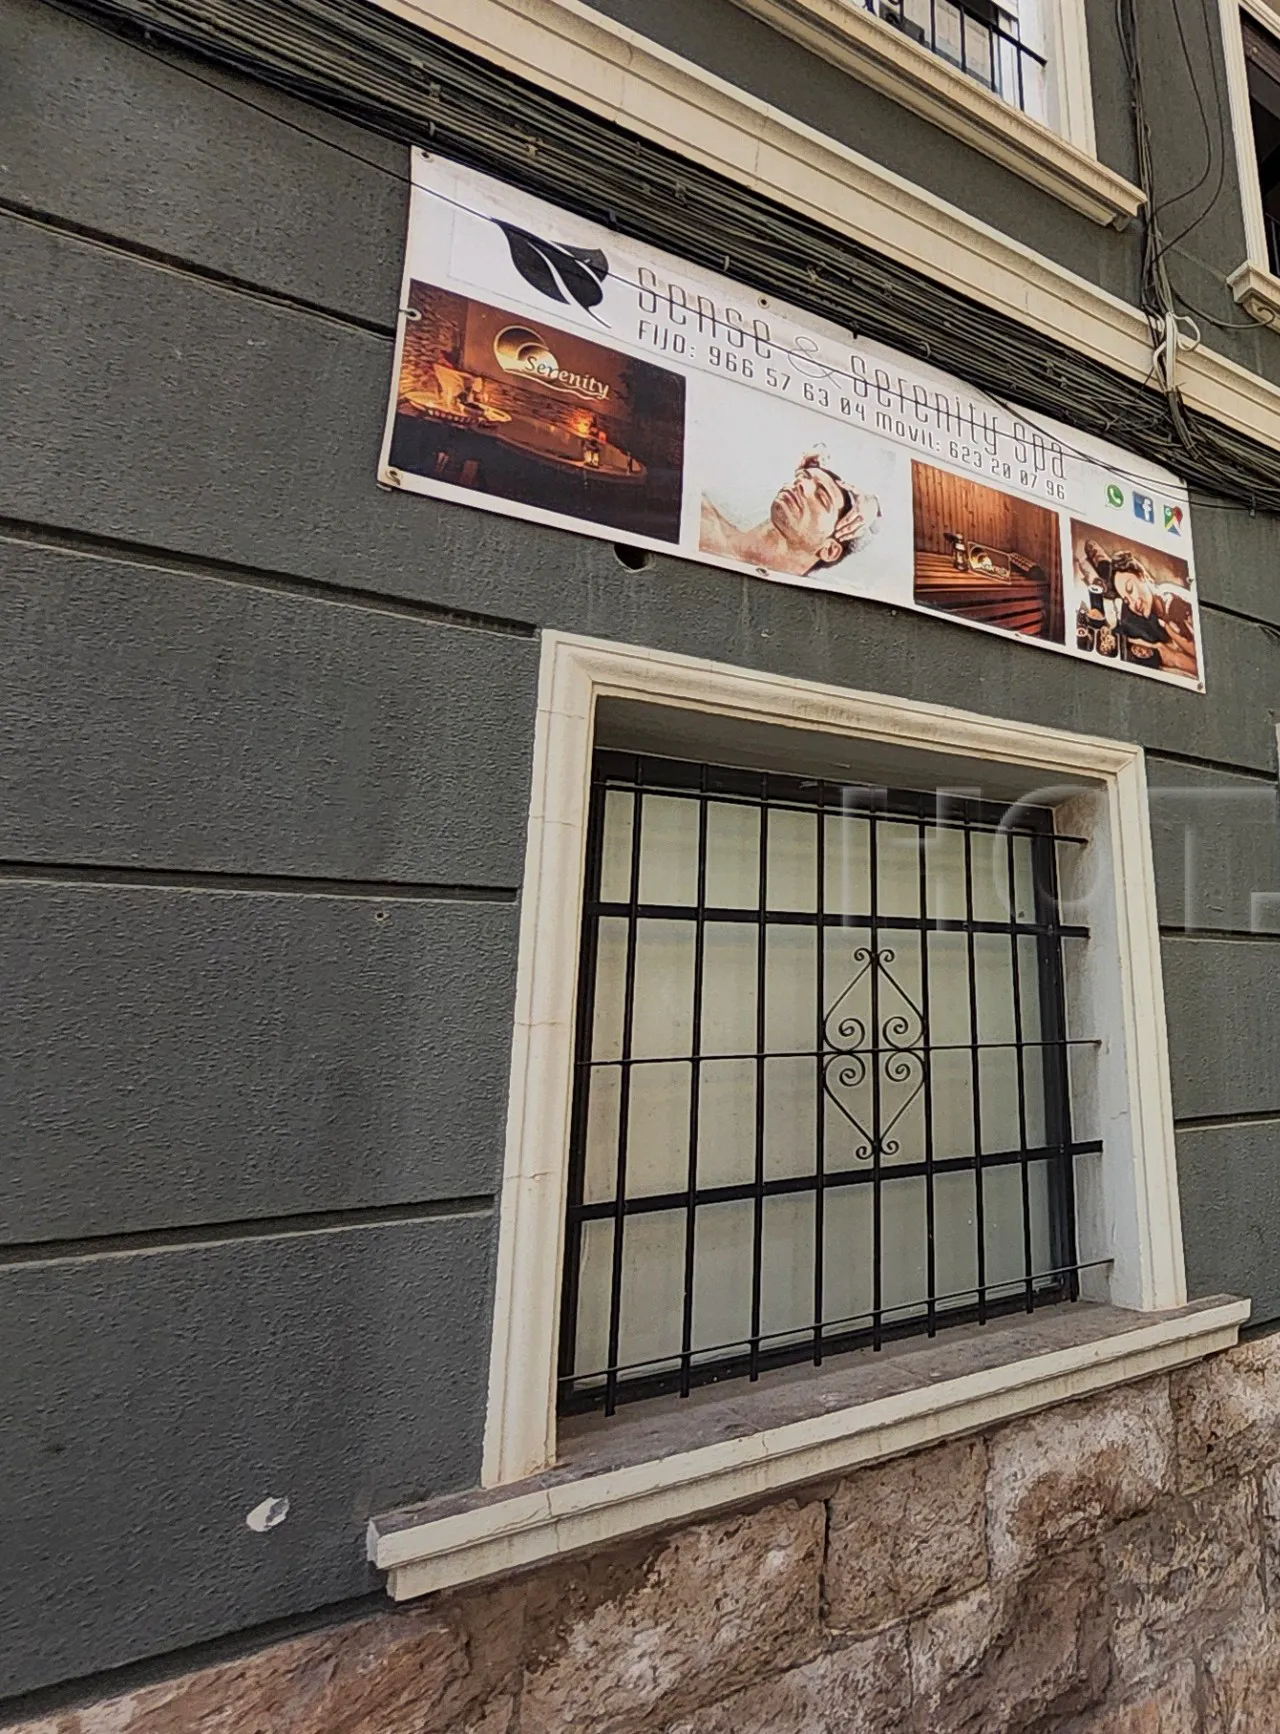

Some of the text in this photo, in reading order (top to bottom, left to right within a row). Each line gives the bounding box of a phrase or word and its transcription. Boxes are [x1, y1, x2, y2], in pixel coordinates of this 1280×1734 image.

[524, 355, 609, 399] Serenity
[637, 266, 772, 360] Sense
[850, 354, 998, 457] Serenity
[1013, 421, 1068, 480] Spa
[638, 319, 696, 358] FIJO:
[708, 345, 754, 379] 966
[766, 368, 791, 391] 57
[803, 381, 829, 407] 63
[840, 396, 865, 422] 04
[949, 439, 983, 468] 623
[991, 457, 1011, 480] 20
[1019, 468, 1038, 491] 07
[1046, 480, 1066, 502] 96
